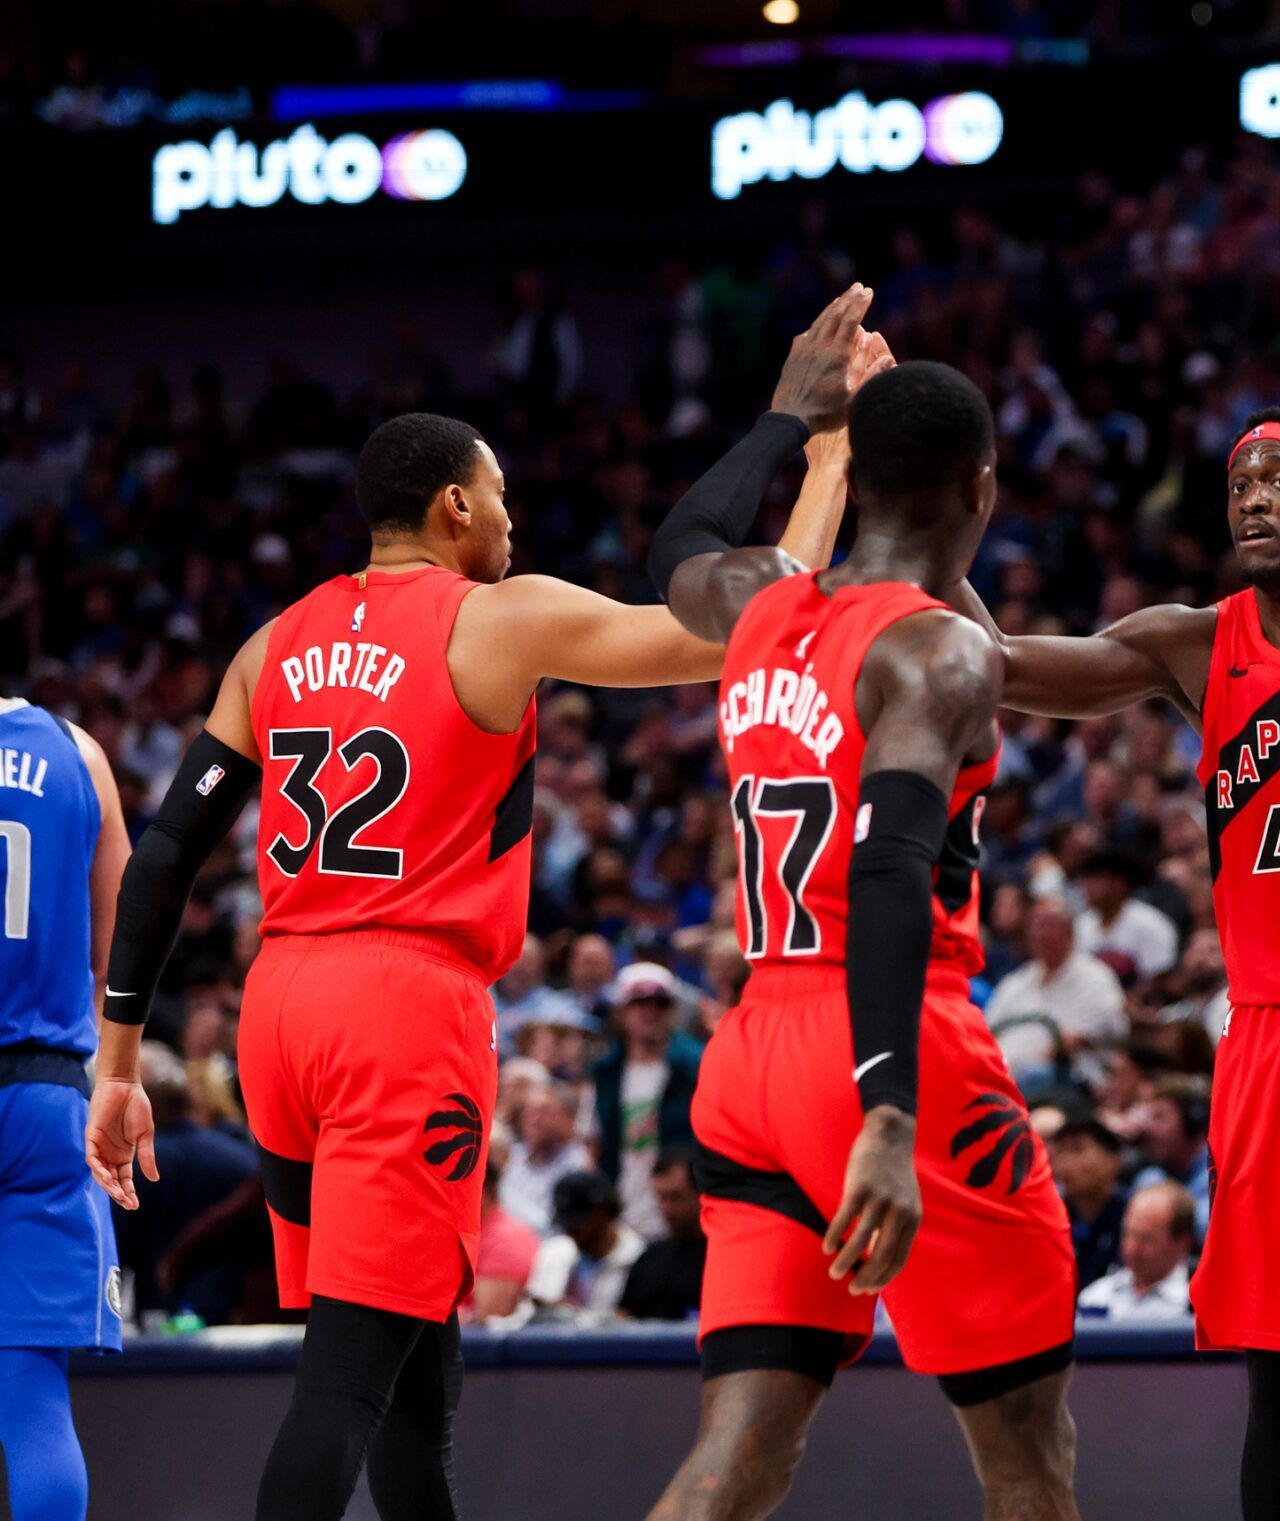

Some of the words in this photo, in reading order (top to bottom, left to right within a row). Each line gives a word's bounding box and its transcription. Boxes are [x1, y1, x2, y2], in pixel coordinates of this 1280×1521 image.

[153, 124, 381, 224] pluto
[711, 89, 926, 199] pluto
[281, 642, 405, 703] PORTER
[0, 748, 48, 797] ELL
[266, 726, 411, 880] 32
[730, 774, 838, 959] 17
